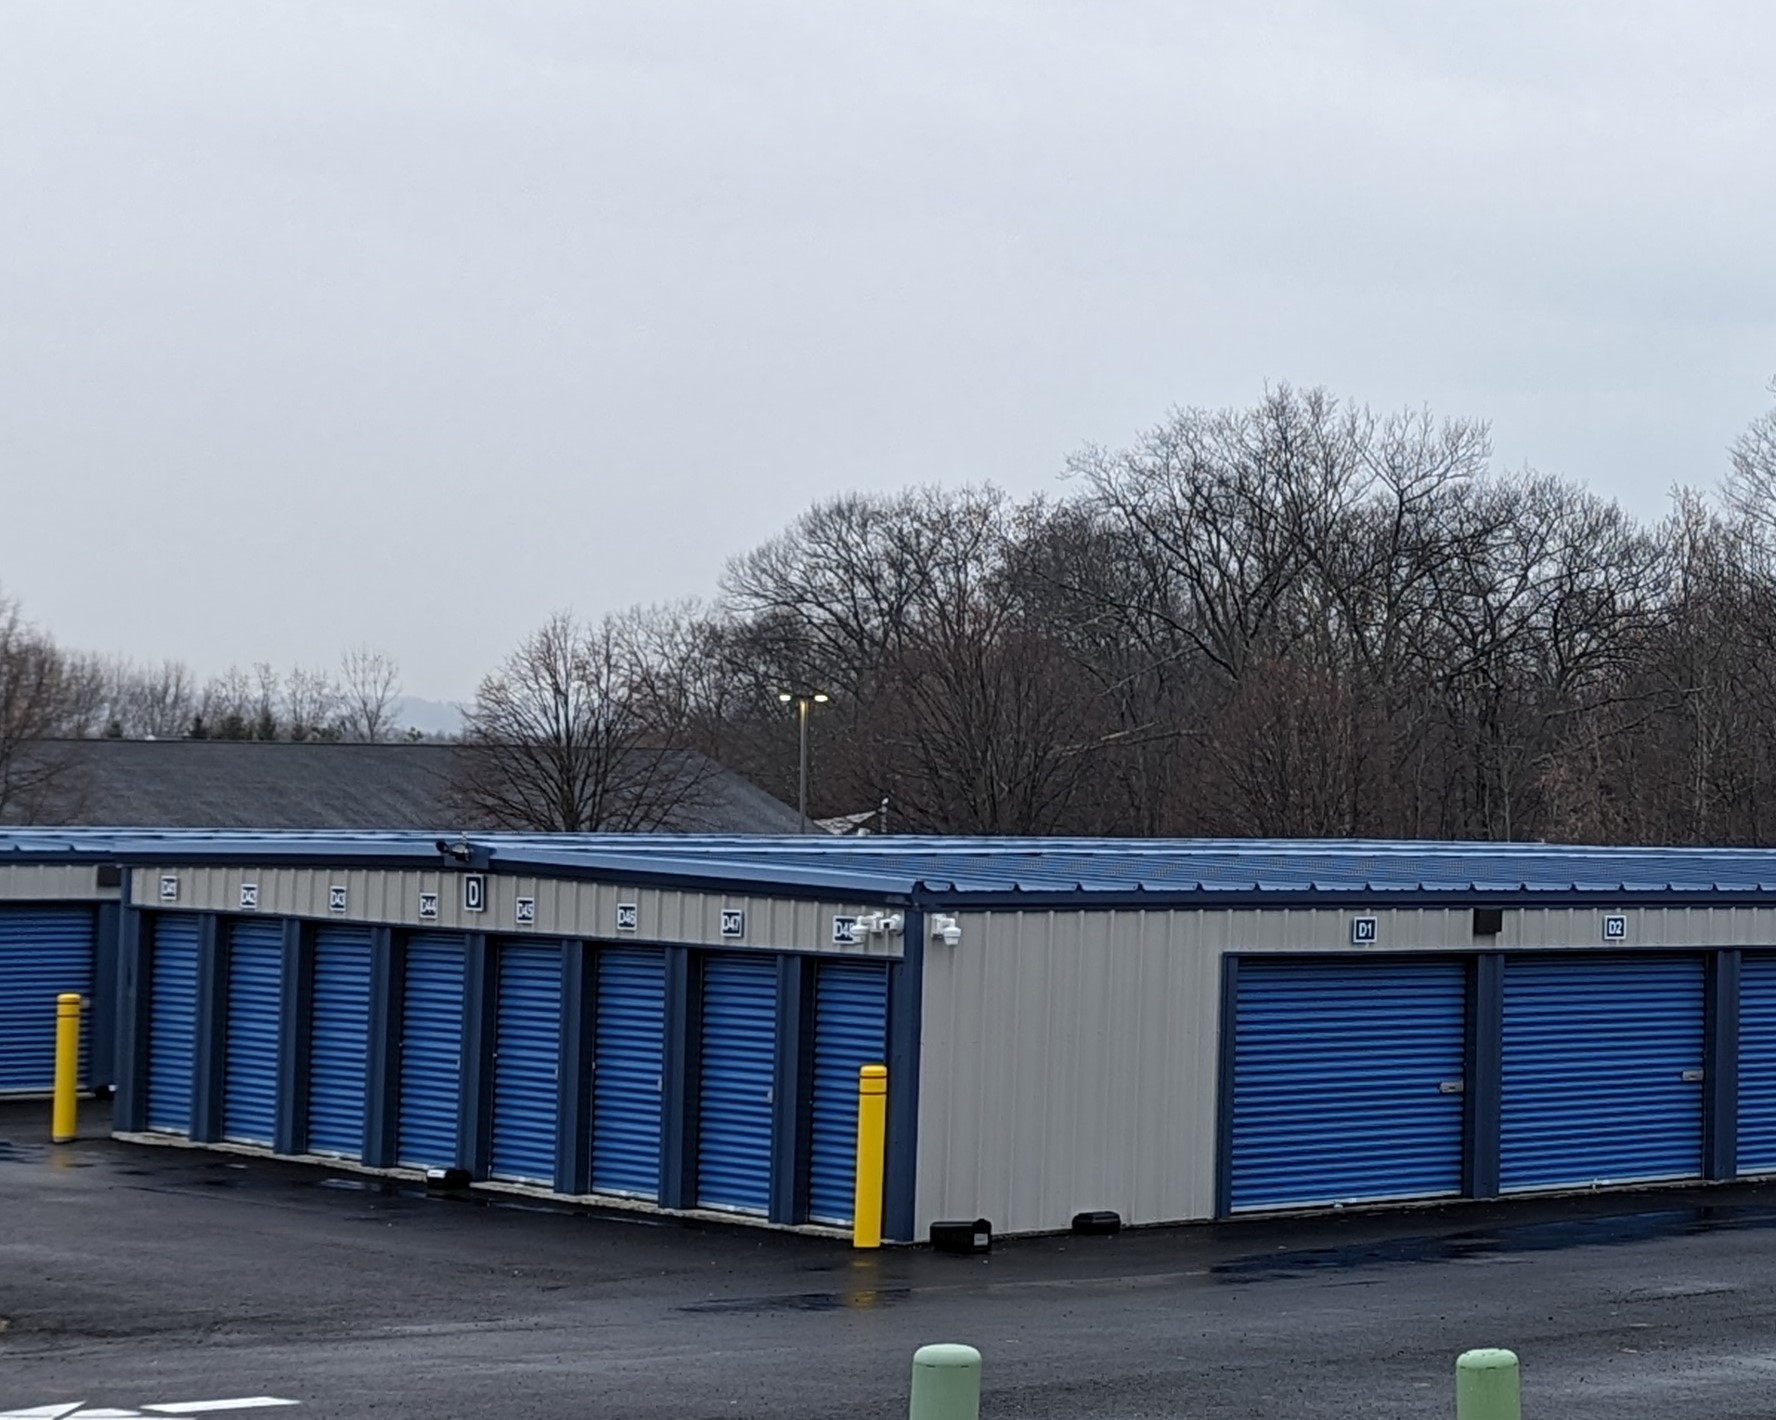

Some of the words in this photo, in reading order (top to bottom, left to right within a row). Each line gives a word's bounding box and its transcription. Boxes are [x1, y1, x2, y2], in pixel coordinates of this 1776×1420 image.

[468, 880, 479, 906] D
[1358, 922, 1372, 937] D1
[1608, 920, 1622, 935] D2
